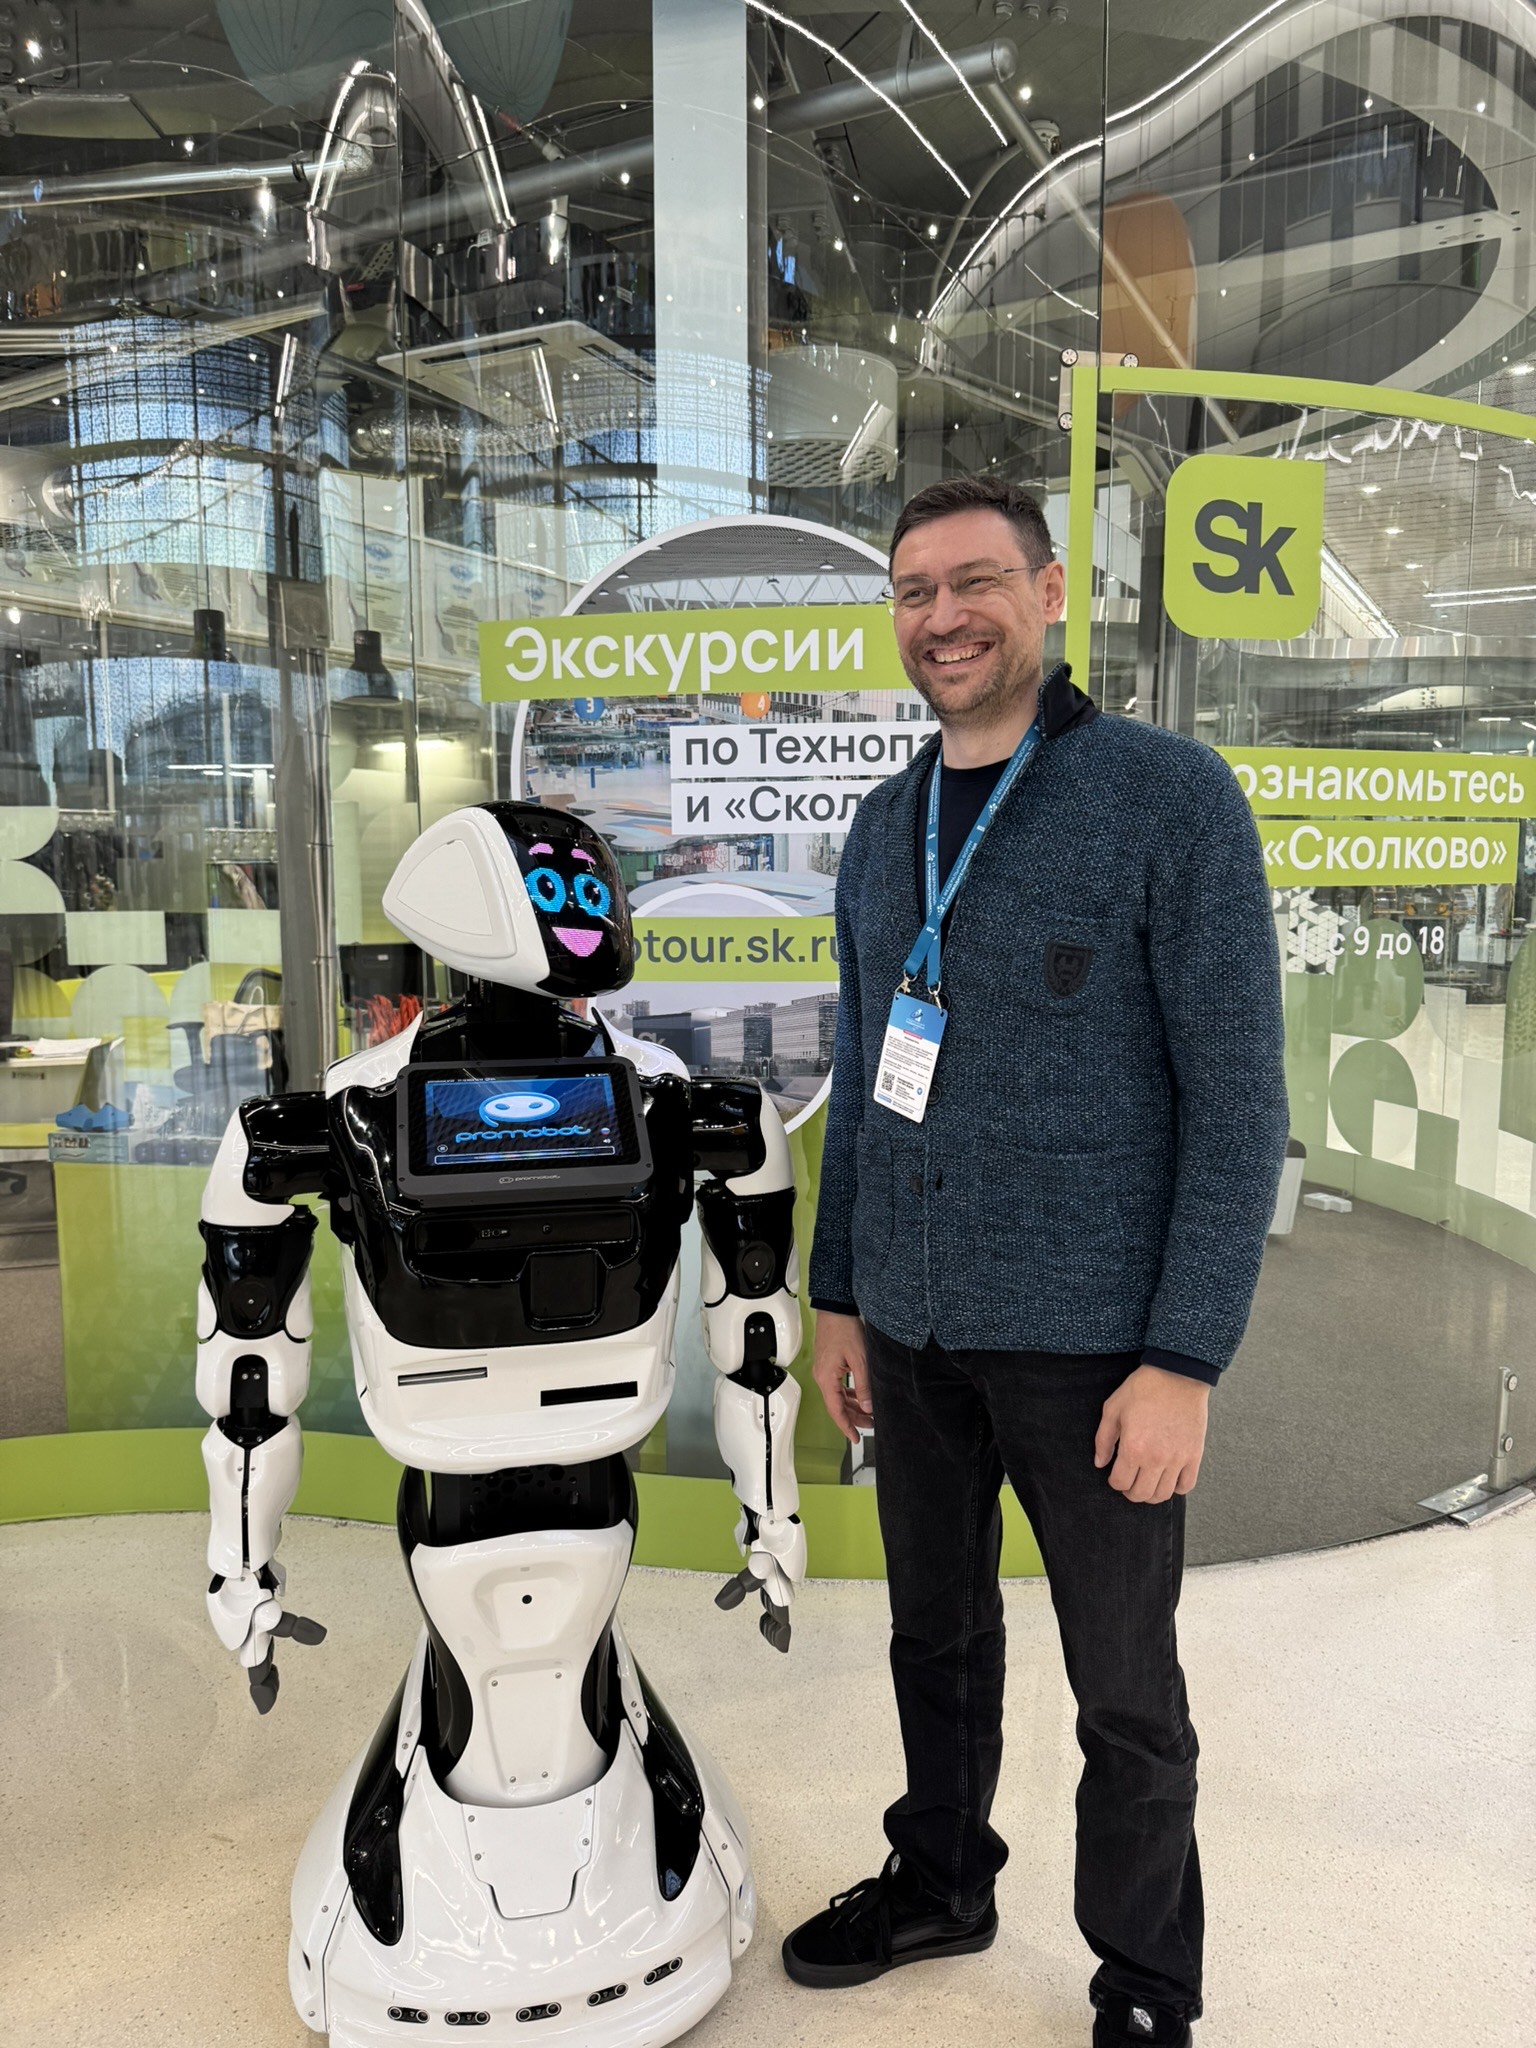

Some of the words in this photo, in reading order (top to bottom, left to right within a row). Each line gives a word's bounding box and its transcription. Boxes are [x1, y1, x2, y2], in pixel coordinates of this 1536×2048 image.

[1192, 498, 1298, 597] Sk
[504, 626, 864, 693] Экскурсии
[685, 737, 739, 765] по
[749, 728, 935, 764] Техноп
[686, 795, 710, 822] и
[1263, 825, 1508, 870] «Сколково»
[1329, 932, 1346, 956] с
[1353, 926, 1370, 956] 9
[1376, 933, 1412, 960] до
[1418, 925, 1444, 954] 18
[455, 1125, 591, 1143] promobot
